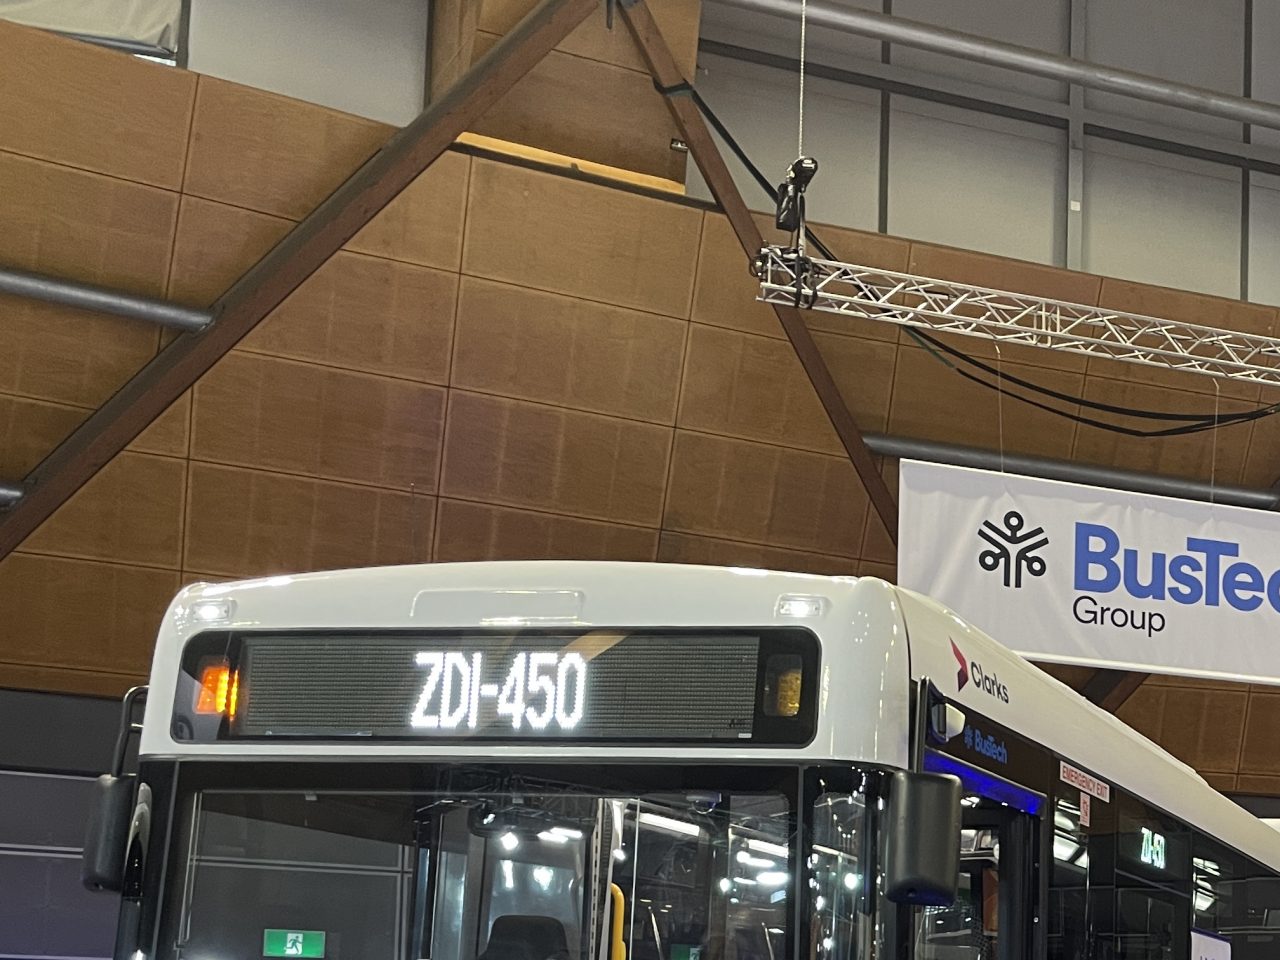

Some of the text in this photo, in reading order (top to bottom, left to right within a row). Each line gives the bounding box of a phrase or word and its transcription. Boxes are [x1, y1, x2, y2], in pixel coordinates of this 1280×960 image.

[1072, 595, 1166, 638] Group
[410, 651, 588, 731] ZDI-450
[971, 661, 1010, 704] Clarks
[974, 729, 1009, 764] BusTech
[1062, 765, 1108, 798] EMERGENCY EXIT
